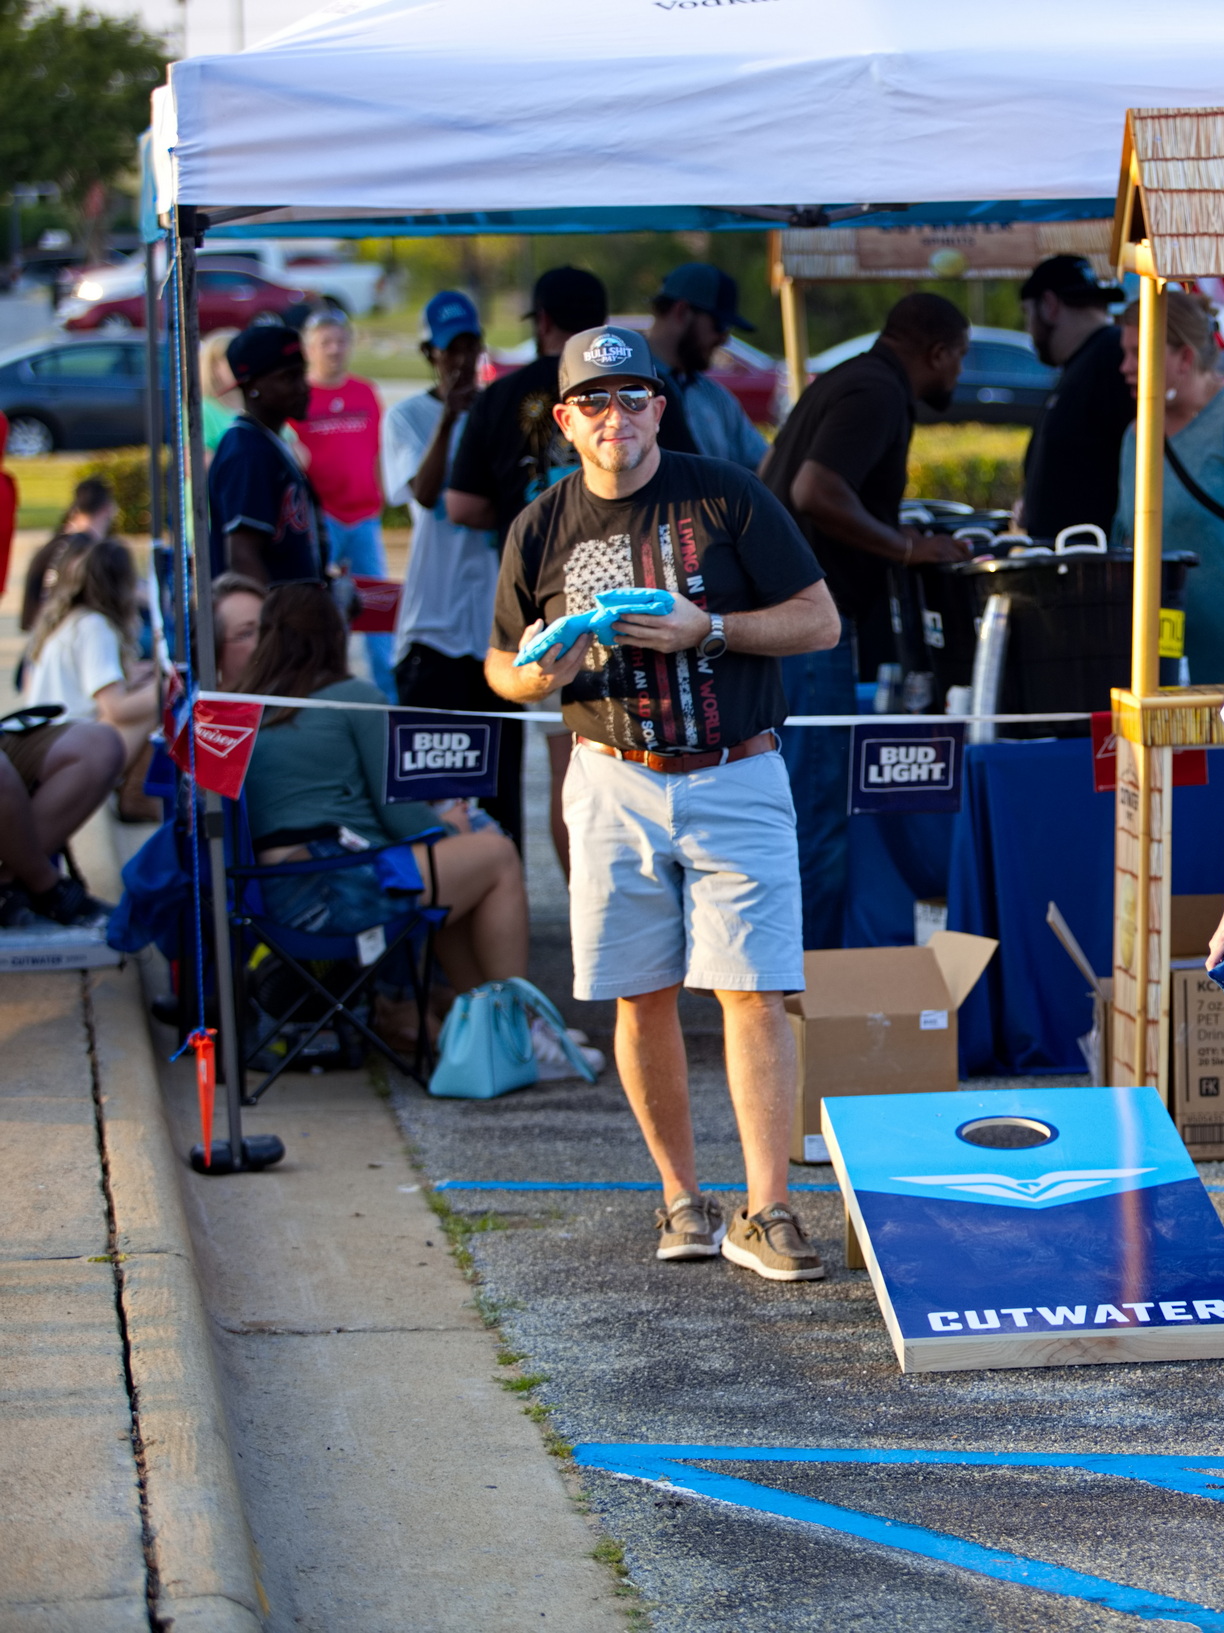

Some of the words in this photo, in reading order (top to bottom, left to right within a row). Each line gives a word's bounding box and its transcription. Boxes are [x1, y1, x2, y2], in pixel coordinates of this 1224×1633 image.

[583, 346, 633, 362] BULLSHIT
[601, 355, 617, 363] PAY
[677, 518, 699, 573] LIVING
[686, 574, 705, 594] IN
[633, 670, 648, 689] AN
[638, 690, 651, 718] OLD
[700, 679, 721, 745] WORLD
[413, 732, 471, 751] BUD
[403, 750, 481, 771] LIGHT
[879, 746, 936, 765] BUD
[868, 762, 946, 784] LIGHT
[1198, 1000, 1204, 1011] 7
[1197, 1013, 1220, 1026] PET
